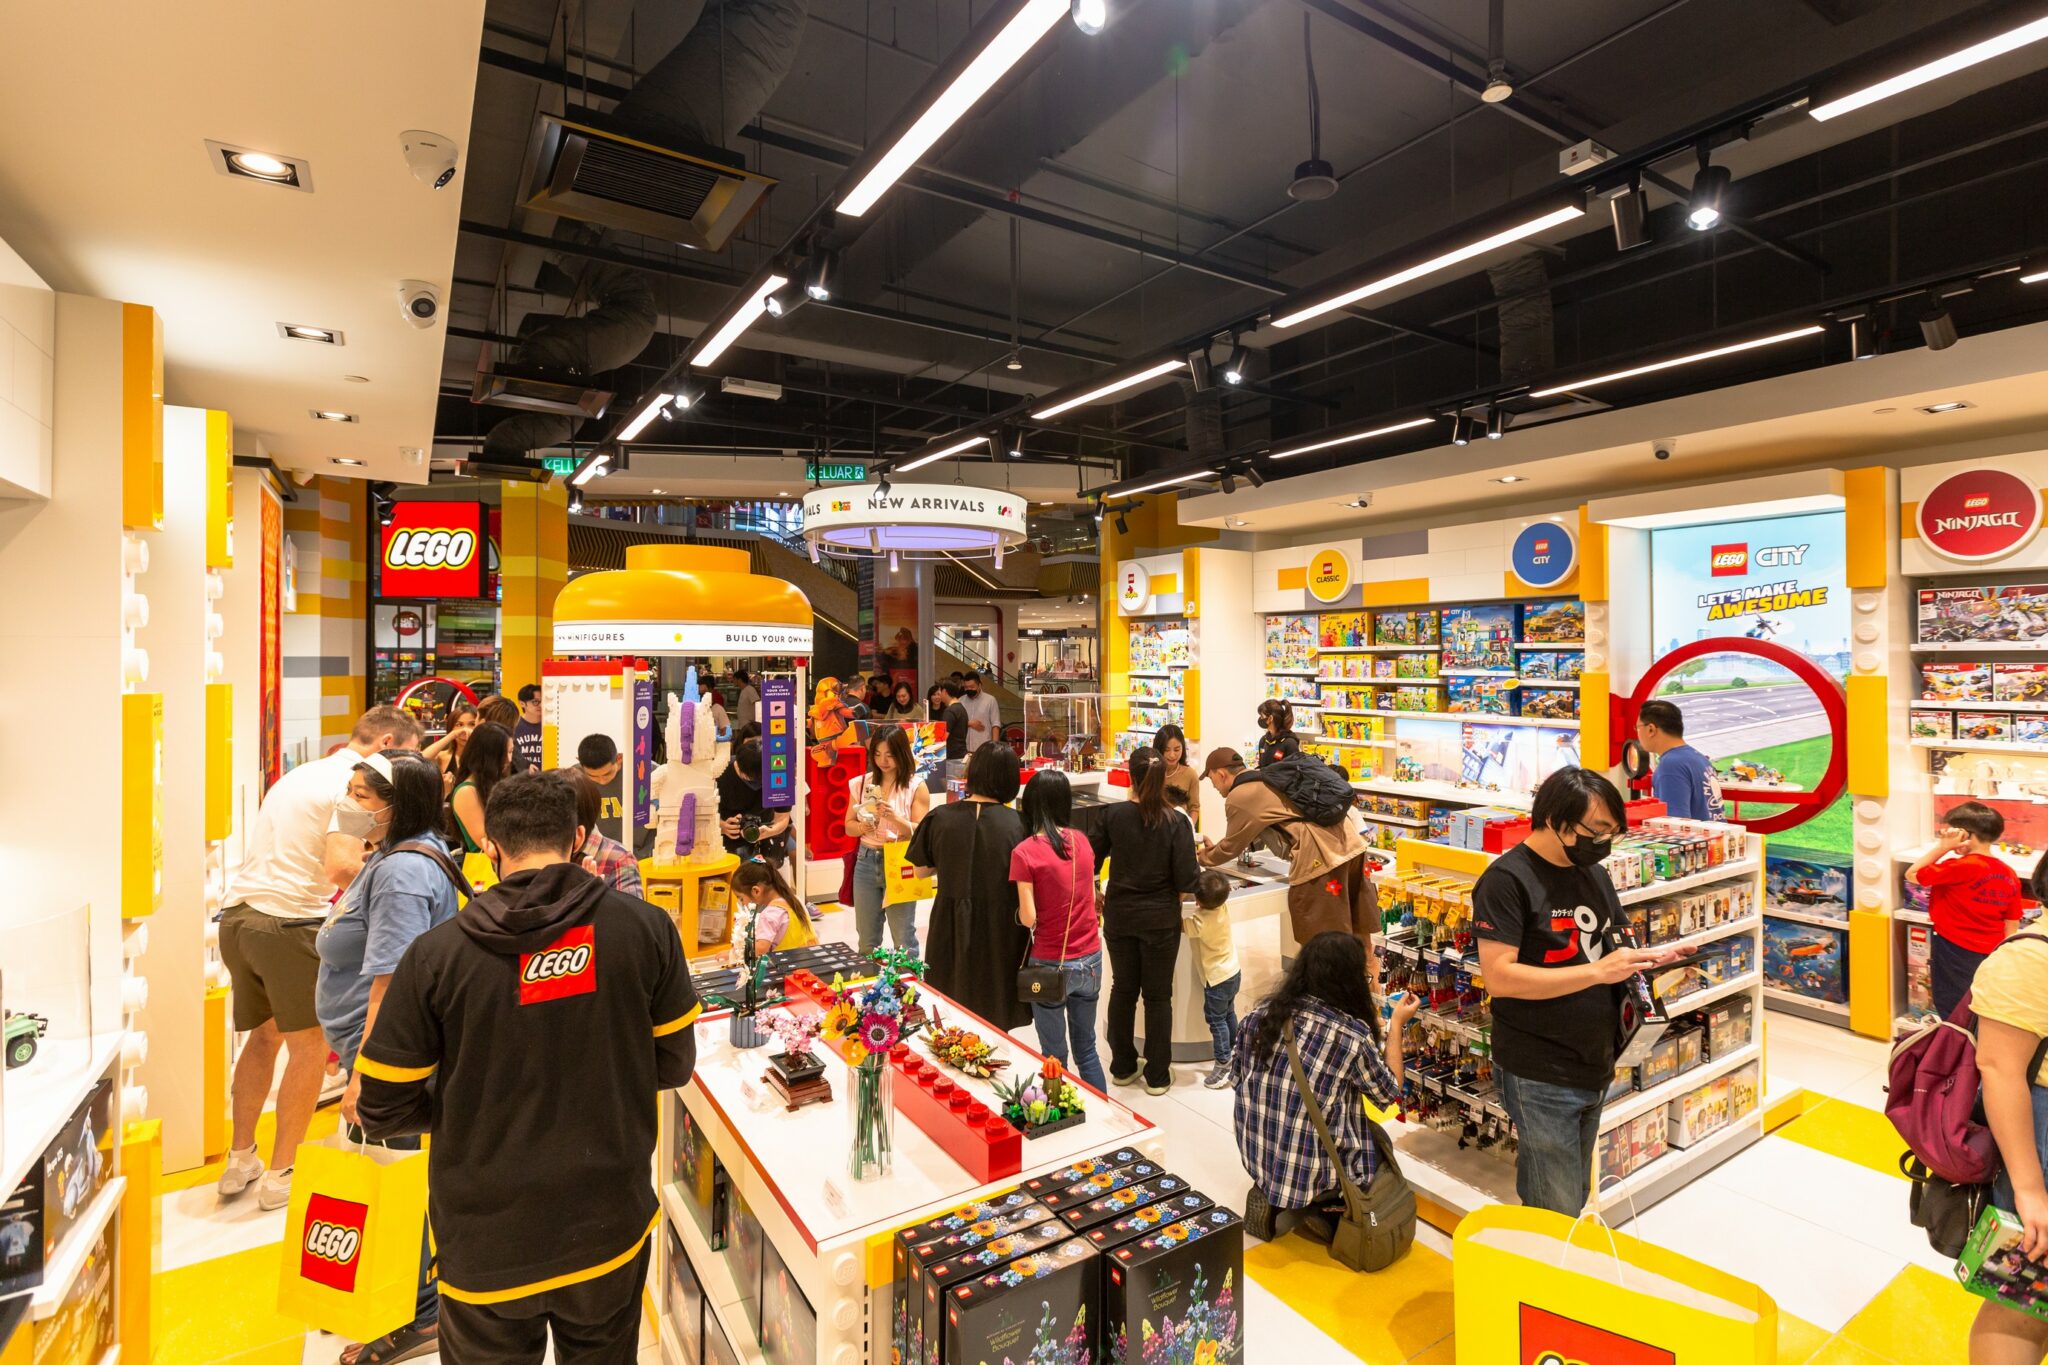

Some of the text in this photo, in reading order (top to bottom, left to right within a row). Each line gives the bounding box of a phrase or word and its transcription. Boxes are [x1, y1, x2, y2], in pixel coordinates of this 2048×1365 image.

[544, 459, 582, 473] KELU
[808, 466, 853, 479] KELUAR
[868, 497, 985, 513] NEW ARRIVALS
[1933, 511, 2024, 536] NINJAGO
[387, 530, 474, 568] LEGO
[1712, 544, 1810, 568] LEGO CITY
[1532, 555, 1551, 565] CITY
[1316, 575, 1340, 583] CLASSIC
[1698, 580, 1798, 609] LET'S MAKE
[1936, 591, 1984, 601] NINJAGO
[1707, 587, 1828, 621] AWESOME
[568, 633, 625, 642] MINIFIGURES
[726, 634, 758, 643] BUILD
[762, 635, 785, 643] YOUR
[525, 945, 590, 981] LEGO
[307, 1223, 359, 1261] LEGO
